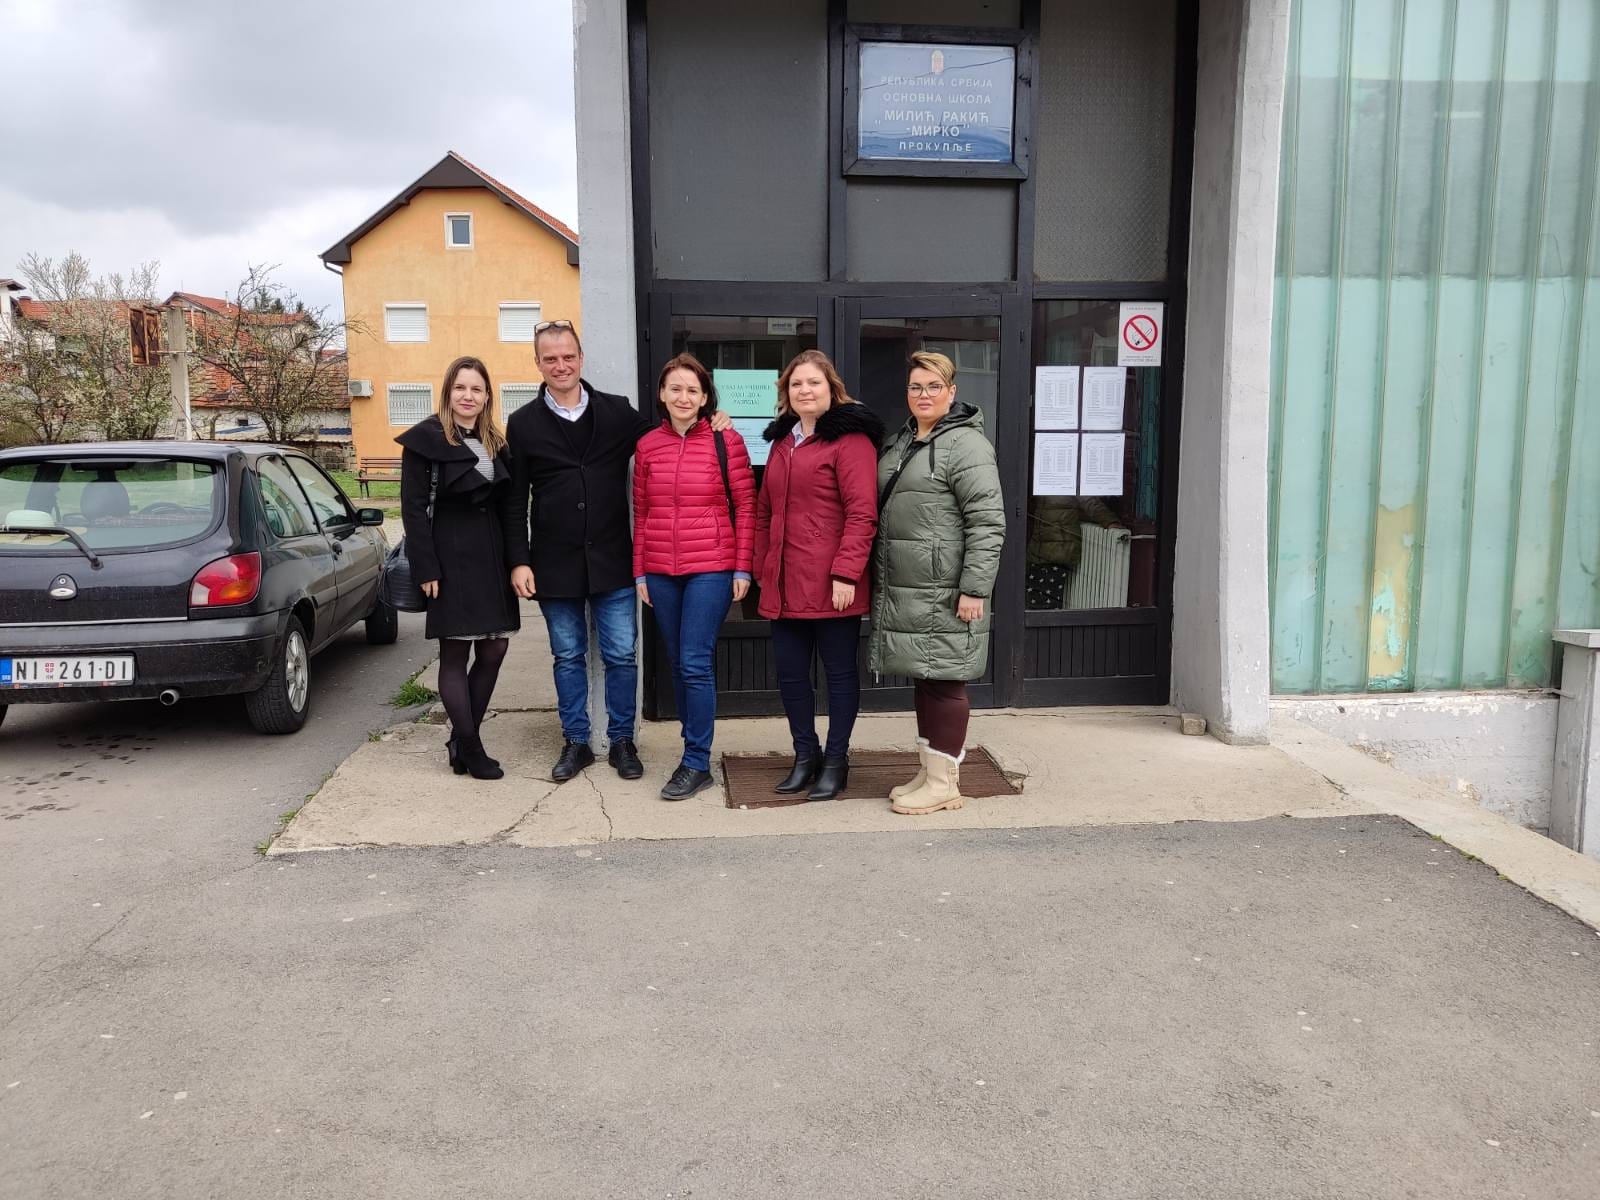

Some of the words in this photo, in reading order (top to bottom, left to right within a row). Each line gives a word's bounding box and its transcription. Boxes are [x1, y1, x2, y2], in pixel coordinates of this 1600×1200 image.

[880, 76, 945, 87] РЕПУБЛИКА
[951, 78, 993, 88] СРБИЈА
[882, 92, 942, 103] ОСНОВНА
[948, 94, 992, 104] ШКОЛА
[943, 112, 990, 124] РАКИЋ
[899, 141, 973, 152] ПРОКУПЉЕ
[16, 661, 38, 680] NI
